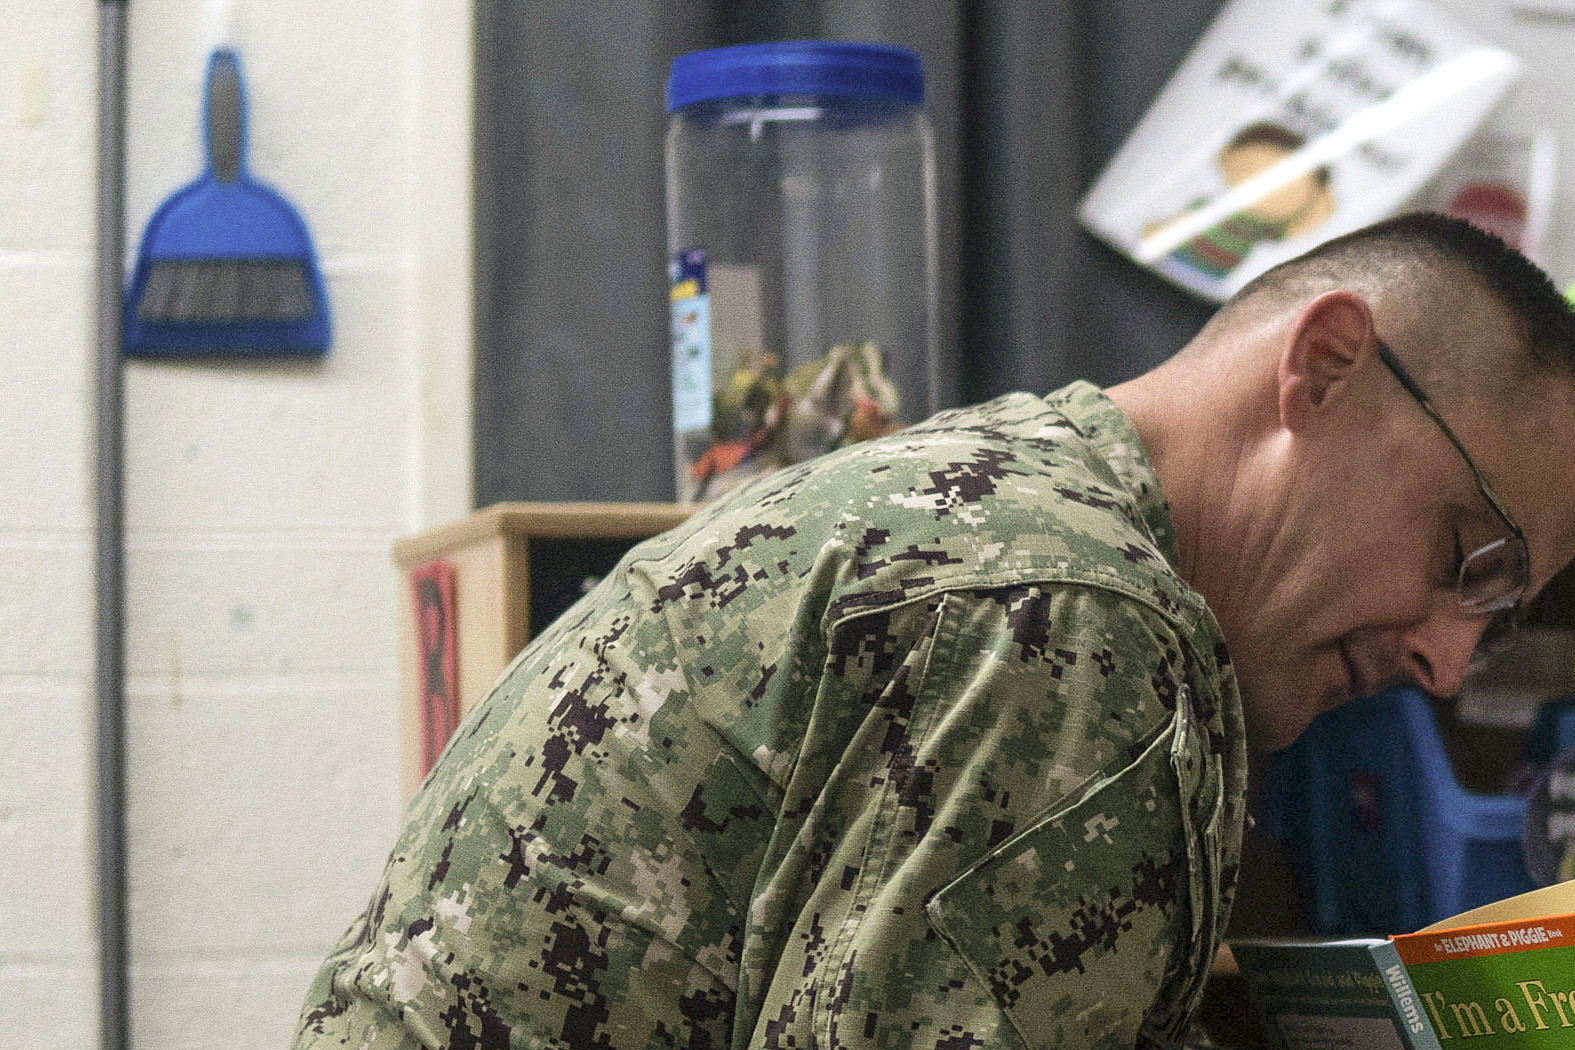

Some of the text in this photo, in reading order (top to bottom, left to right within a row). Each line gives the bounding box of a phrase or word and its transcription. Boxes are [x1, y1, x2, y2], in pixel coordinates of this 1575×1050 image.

[1441, 933, 1500, 954] ELEPHANT
[1500, 934, 1511, 947] &
[1507, 926, 1550, 946] PIGGIE
[1547, 928, 1563, 939] Book
[1385, 964, 1424, 1034] Willems
[1419, 990, 1496, 1040] I'm
[1494, 997, 1526, 1035] a
